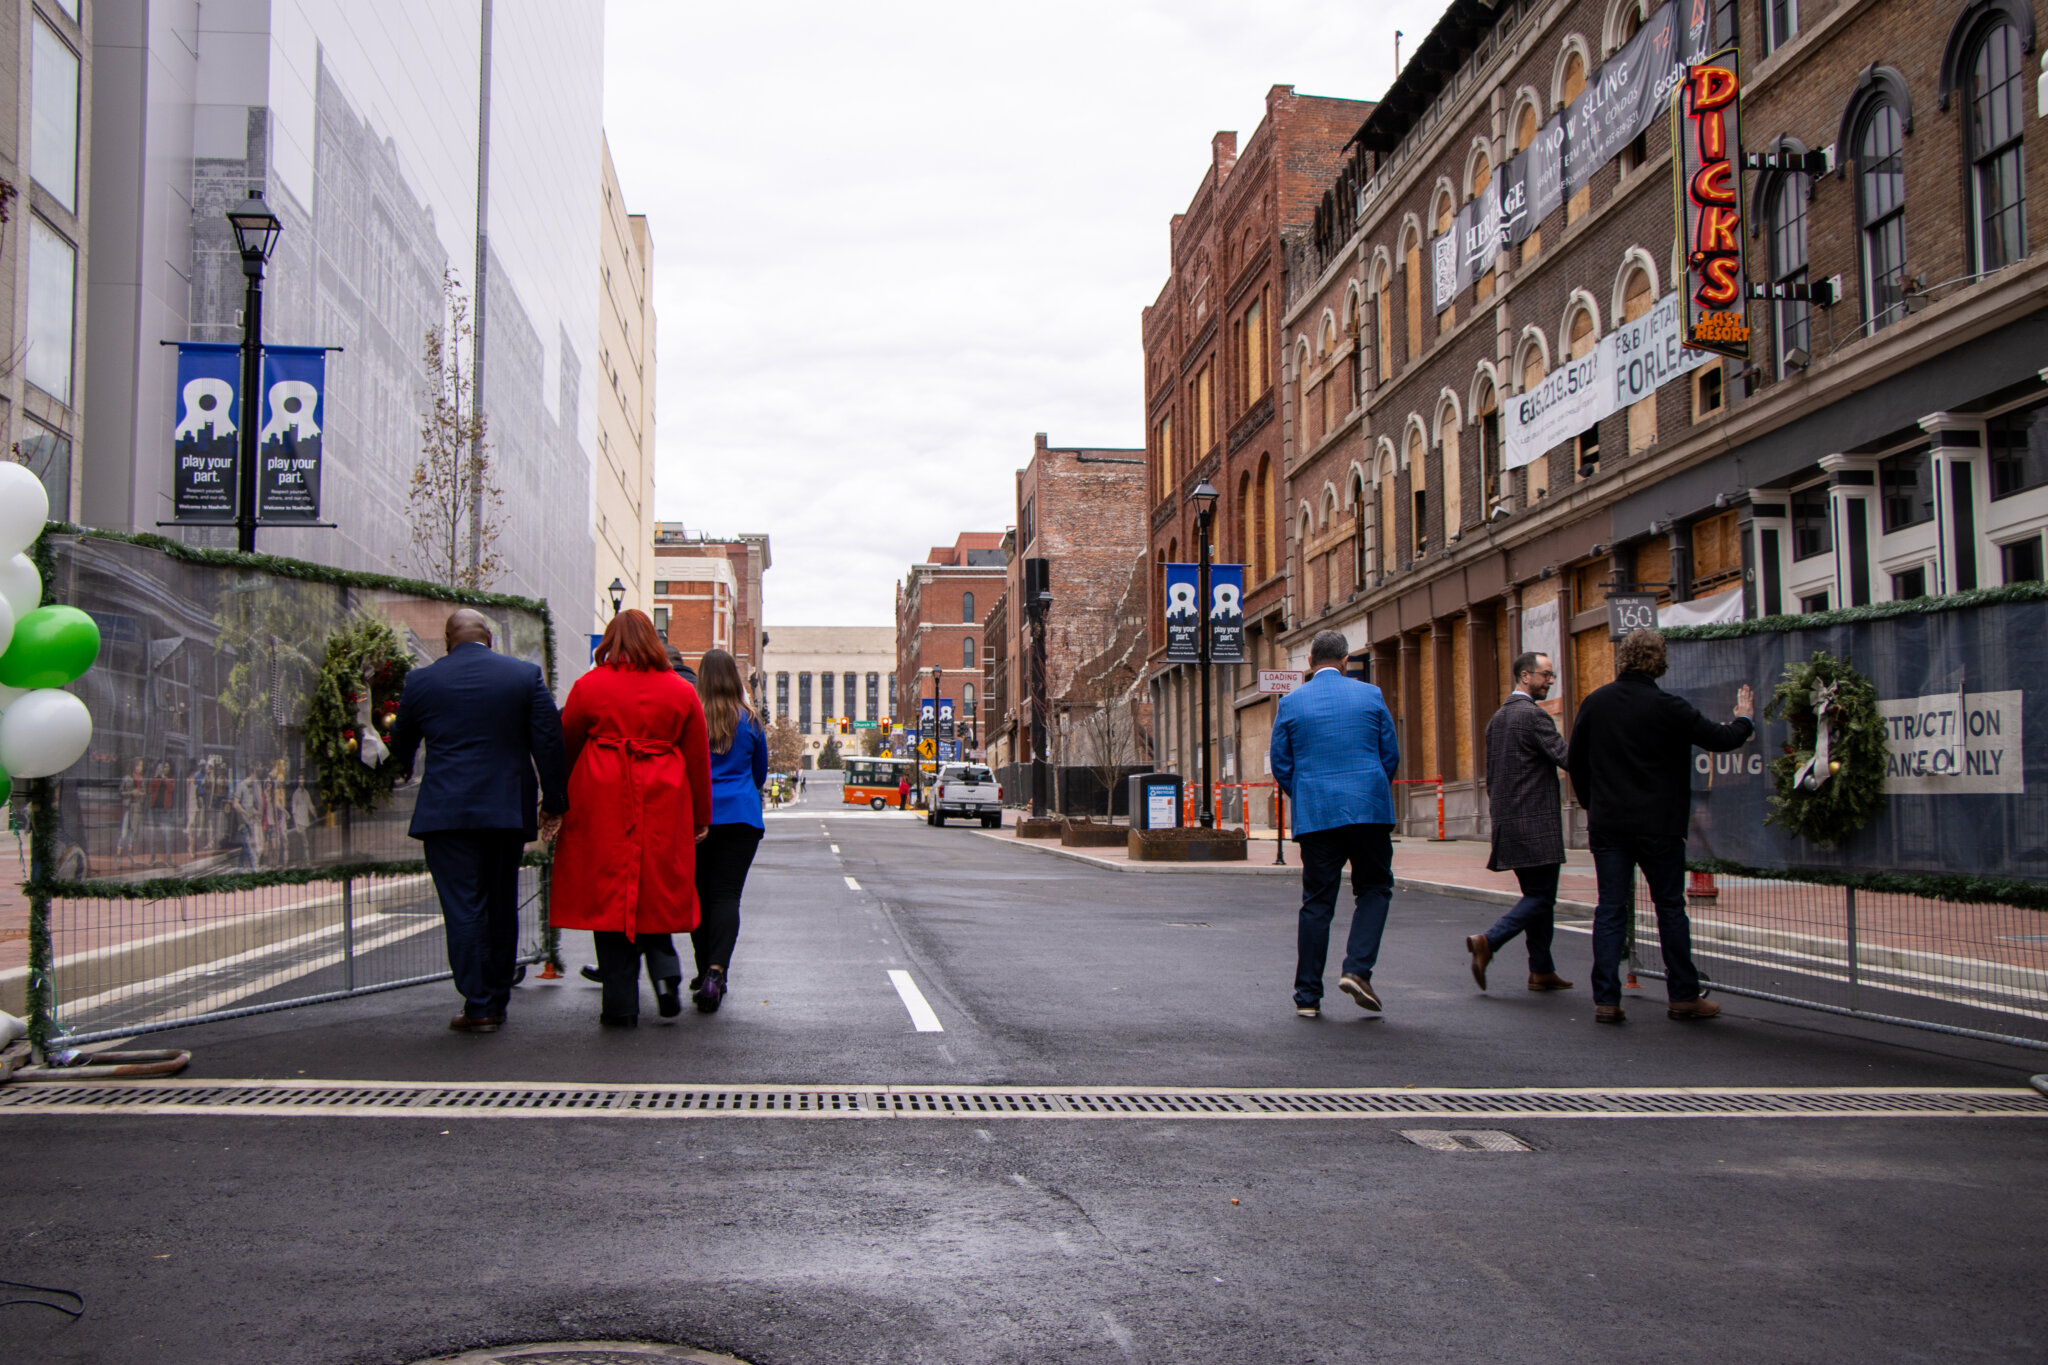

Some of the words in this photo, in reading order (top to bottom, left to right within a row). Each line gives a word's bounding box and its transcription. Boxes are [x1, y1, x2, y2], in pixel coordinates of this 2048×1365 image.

[1546, 114, 1577, 158] NOW
[1582, 62, 1628, 128] SLLING
[1689, 62, 1740, 308] DICK'S
[1465, 180, 1526, 255] HERIAGE
[1701, 310, 1742, 327] LAST
[1616, 327, 1641, 359] F&B
[1650, 299, 1680, 341] ETAI
[1694, 324, 1750, 342] RESORT
[1519, 352, 1599, 426] 615.219.501
[182, 454, 206, 470] play
[207, 457, 233, 470] your
[267, 456, 291, 471] play
[292, 458, 317, 471] your
[193, 470, 221, 484] part.
[278, 471, 304, 486] part.
[1617, 605, 1653, 628] 160
[1169, 625, 1182, 635] play
[1182, 626, 1196, 634] your
[1175, 633, 1191, 641] part.
[1214, 626, 1227, 635] play
[1226, 626, 1240, 635] your
[1220, 634, 1235, 642] part.
[1264, 673, 1298, 681] LOADING
[1271, 682, 1291, 691] ZONE
